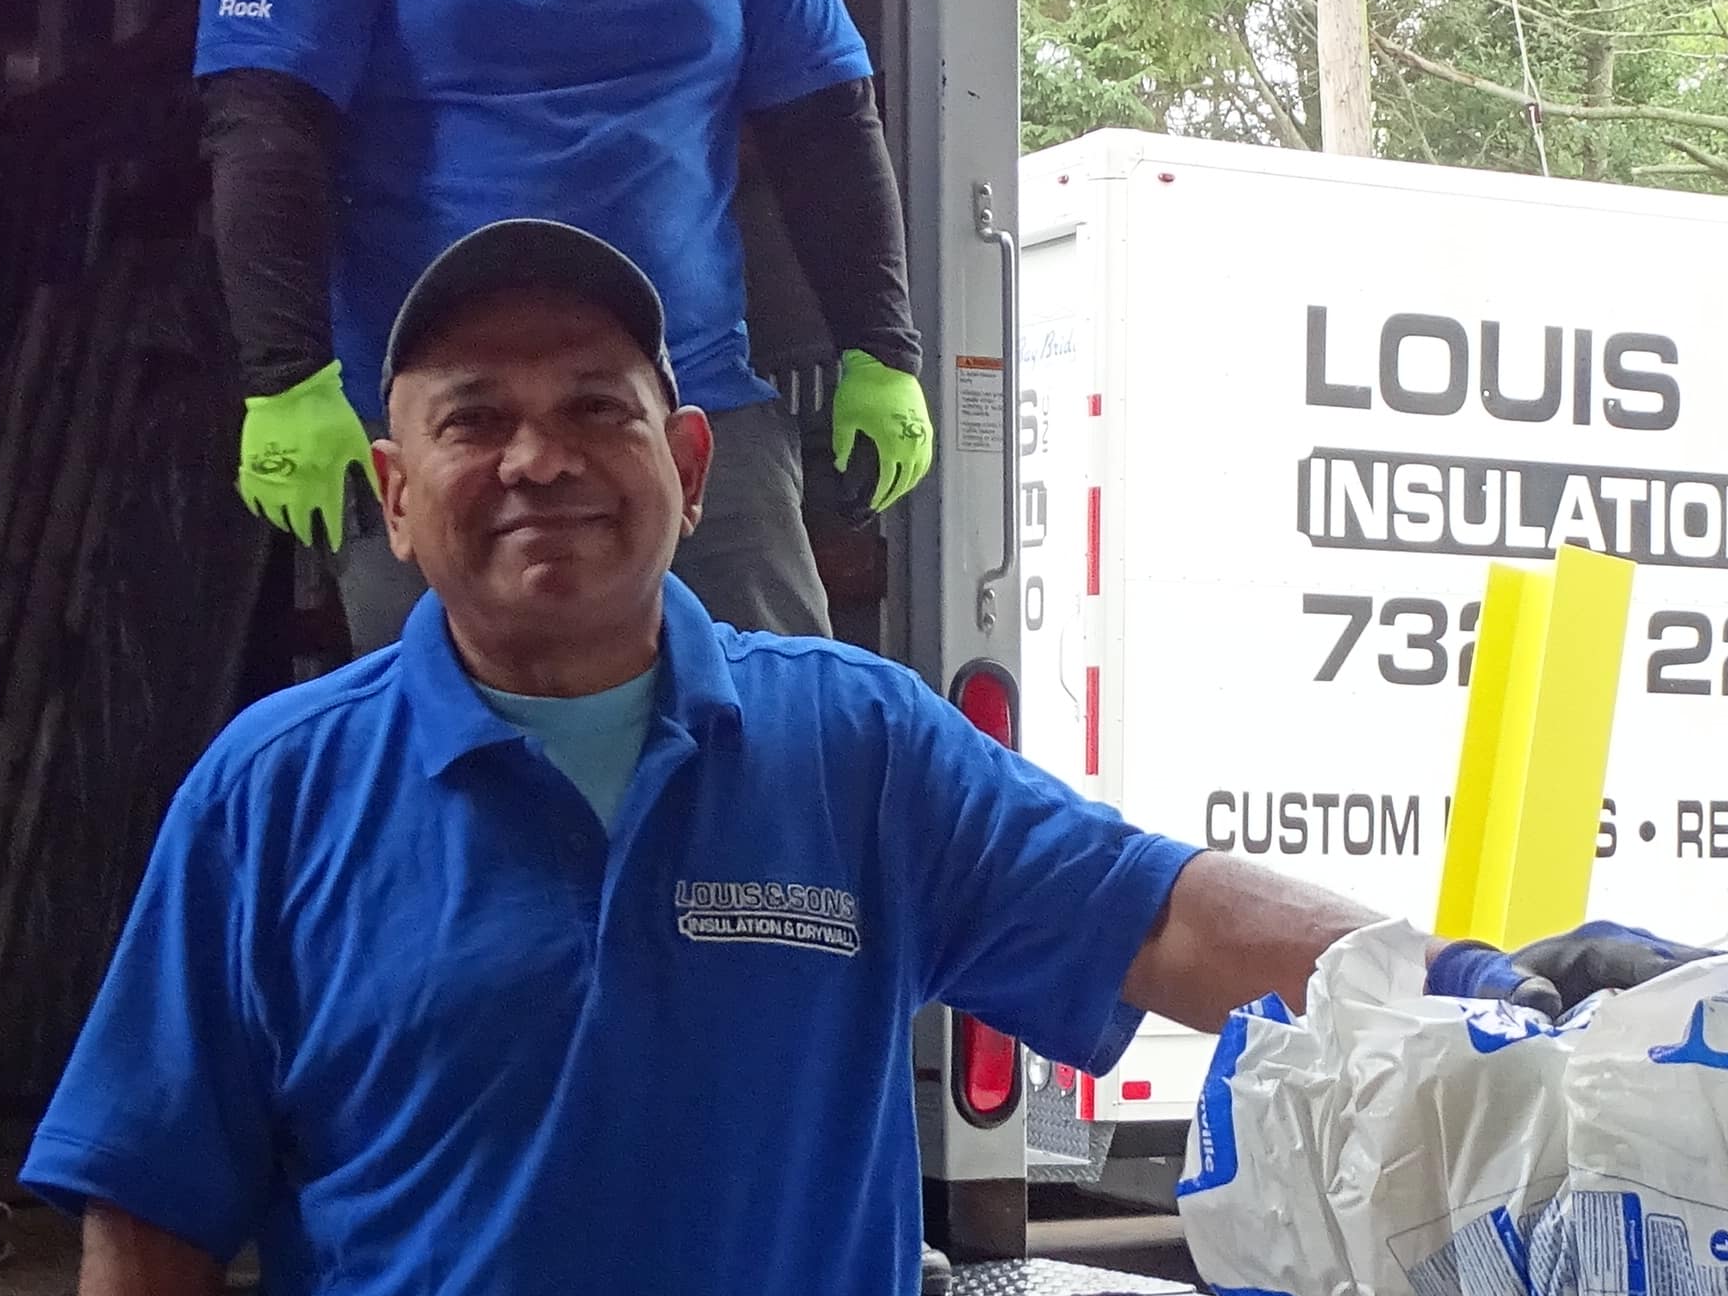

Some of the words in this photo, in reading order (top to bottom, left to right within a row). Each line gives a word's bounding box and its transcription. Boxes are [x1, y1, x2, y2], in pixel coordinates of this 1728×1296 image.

[1305, 305, 1679, 432] LOUIS
[1300, 591, 1483, 687] 73
[1204, 790, 1421, 859] CUSTOM
[675, 880, 761, 908] LOUIS
[787, 884, 856, 921] SONS
[687, 916, 782, 934] INSULATION
[796, 921, 855, 948] DRYWALL
